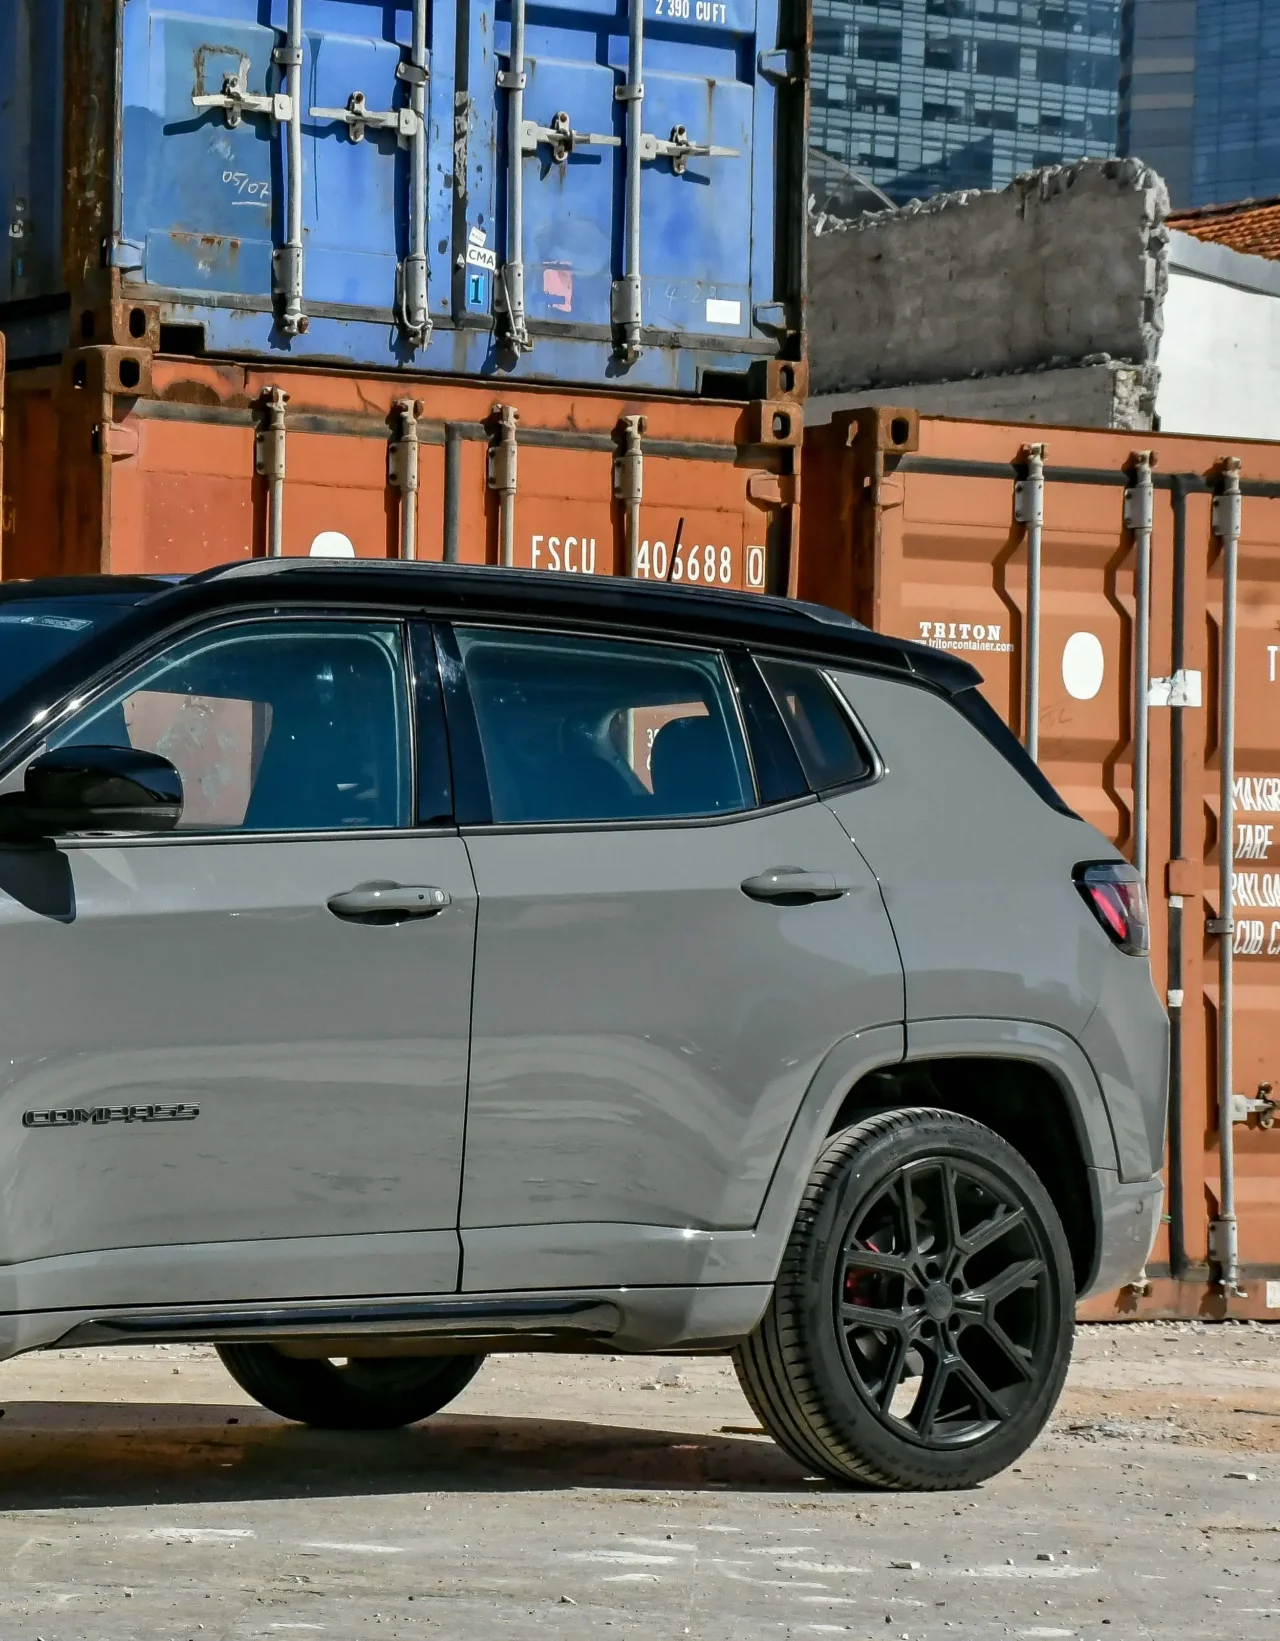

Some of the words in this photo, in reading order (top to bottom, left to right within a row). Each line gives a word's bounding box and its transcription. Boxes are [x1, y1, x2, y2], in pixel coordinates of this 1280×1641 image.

[468, 249, 495, 267] CMA
[636, 540, 733, 584] 406688
[749, 548, 763, 585] 0
[909, 638, 1015, 652] w.tritoncontainer.com
[919, 621, 1002, 641] TRITON
[1267, 645, 1280, 682] T
[1234, 824, 1274, 860] TARE
[1233, 920, 1265, 955] CUB.
[21, 1101, 201, 1129] COMPASS
